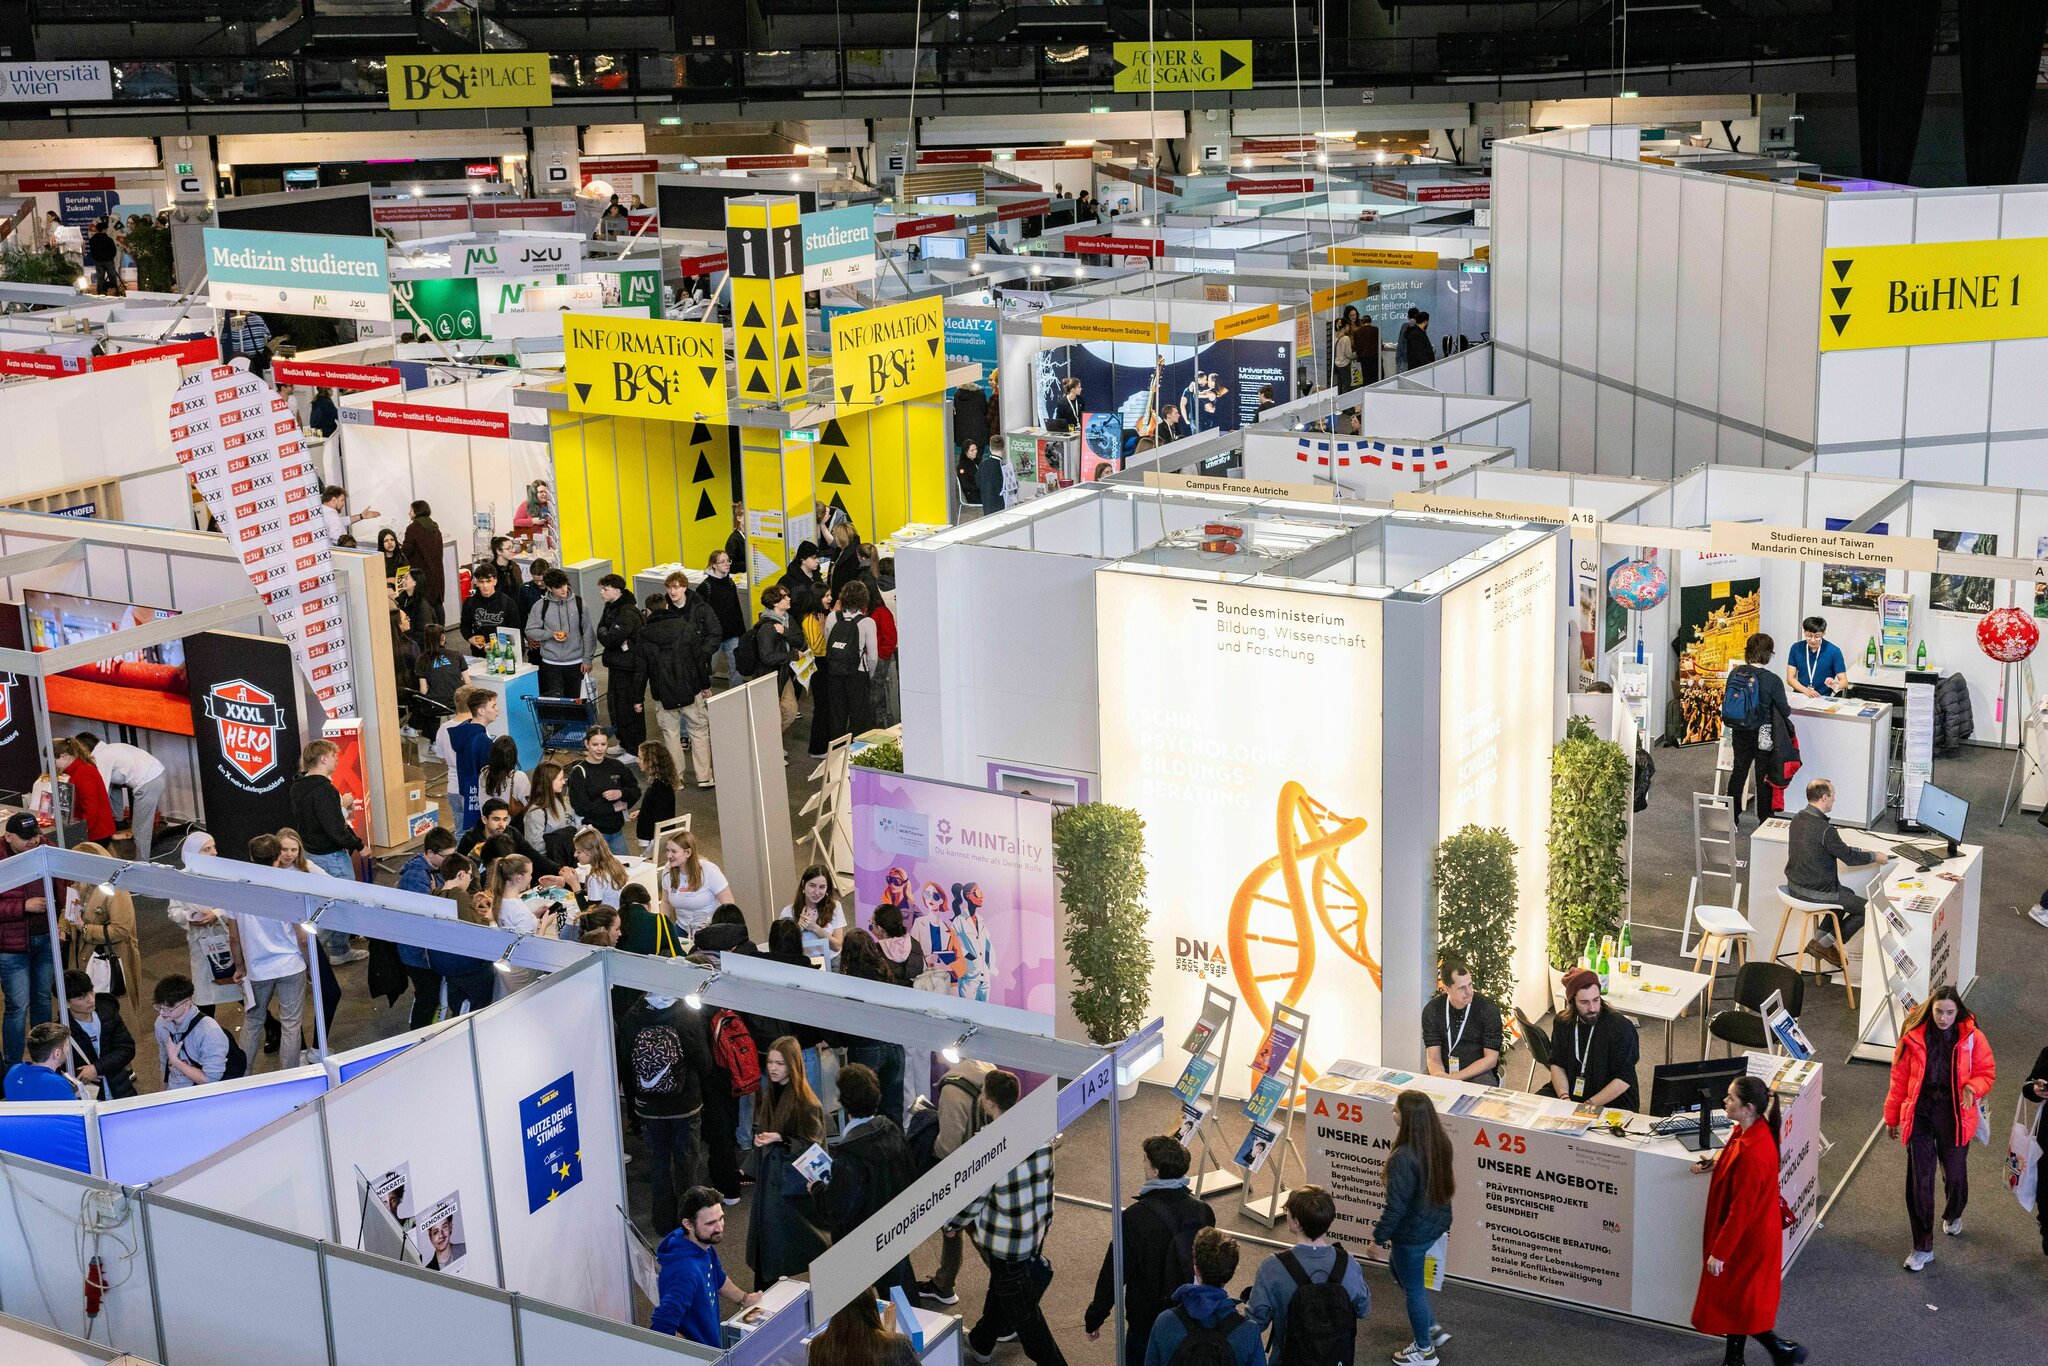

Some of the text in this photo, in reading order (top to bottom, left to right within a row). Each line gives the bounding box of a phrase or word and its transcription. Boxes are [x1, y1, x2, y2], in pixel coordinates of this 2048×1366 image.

[1132, 49, 1205, 67] FOYER &
[8, 64, 101, 84] universität
[480, 66, 537, 87] PLACE
[1131, 66, 1216, 85] AUSGANG
[11, 79, 59, 96] wien
[889, 156, 904, 170] E
[1205, 147, 1218, 159] F
[550, 167, 567, 181] D
[181, 178, 200, 192] C
[65, 195, 102, 204] Berufe mit
[66, 204, 95, 212] Zukunft
[806, 223, 870, 250] studieren
[212, 247, 379, 278] Medizin studieren
[1381, 280, 1410, 290] ersität
[1887, 273, 2020, 314] BüHNE 1
[6, 359, 20, 368] Ärzte
[34, 362, 56, 370] Grenzen
[1238, 366, 1282, 375] Universität
[378, 410, 505, 429] Kepos Institut für Qualitätsausbildungen
[1186, 480, 1290, 496] Campus France Autriche
[1572, 514, 1594, 524] A 18
[1770, 532, 1874, 549] Studieren auf Taiwan
[1751, 542, 1797, 555] Mandarin
[1799, 546, 1856, 560] Chinesisch
[1858, 550, 1894, 563] Lernen
[2035, 566, 2044, 577] A
[1216, 600, 1346, 628] Bundesministerium
[1216, 619, 1366, 650] Bildung, Wissenschaft
[1217, 640, 1316, 665] und Forschung
[225, 702, 266, 723] XXXL
[226, 724, 270, 752] HERO
[960, 828, 1043, 862] MINTality
[934, 846, 944, 856] Du
[946, 849, 970, 861] kannst
[971, 853, 990, 864] mehr
[990, 857, 1001, 866] als
[1176, 936, 1226, 965] DNA
[1088, 1068, 1110, 1099] A 32
[526, 1102, 574, 1140] NUTZE DEINE
[1313, 1098, 1363, 1124] A 25
[536, 1120, 566, 1146] STIMME.
[1317, 1126, 1392, 1151] UNSERE AN
[1473, 1127, 1492, 1149] A
[1498, 1132, 1528, 1154] 25
[1325, 1149, 1386, 1167] PSYCHOLOGISC
[1331, 1172, 1386, 1188] Begabungsfö
[1478, 1156, 1619, 1196] UNSERE ANGEBOTE:
[875, 1136, 1008, 1253] Europäisches Parlament
[1331, 1181, 1386, 1200] Verhaltensauff
[1331, 1192, 1386, 1210] Laufbahnfrage
[1486, 1181, 1589, 1210] PRÄVENTIONSPROJEKTE
[1486, 1192, 1555, 1214] FÜR PSYCHISCHE
[1486, 1202, 1539, 1220] GESUNDHEIT
[421, 1204, 457, 1231] DEMOKRATIE
[1333, 1212, 1354, 1224] BEIT
[1356, 1216, 1370, 1226] MIT
[1486, 1222, 1612, 1255] PSYCHOLOGISCHE BERATUNG:
[1492, 1234, 1562, 1256] Lernmanagement
[1492, 1244, 1620, 1280] Stärkung der Lebenskompetenz
[1492, 1256, 1603, 1286] soziale Konfliktbewältigung
[1492, 1266, 1566, 1288] persönliche Krisen
